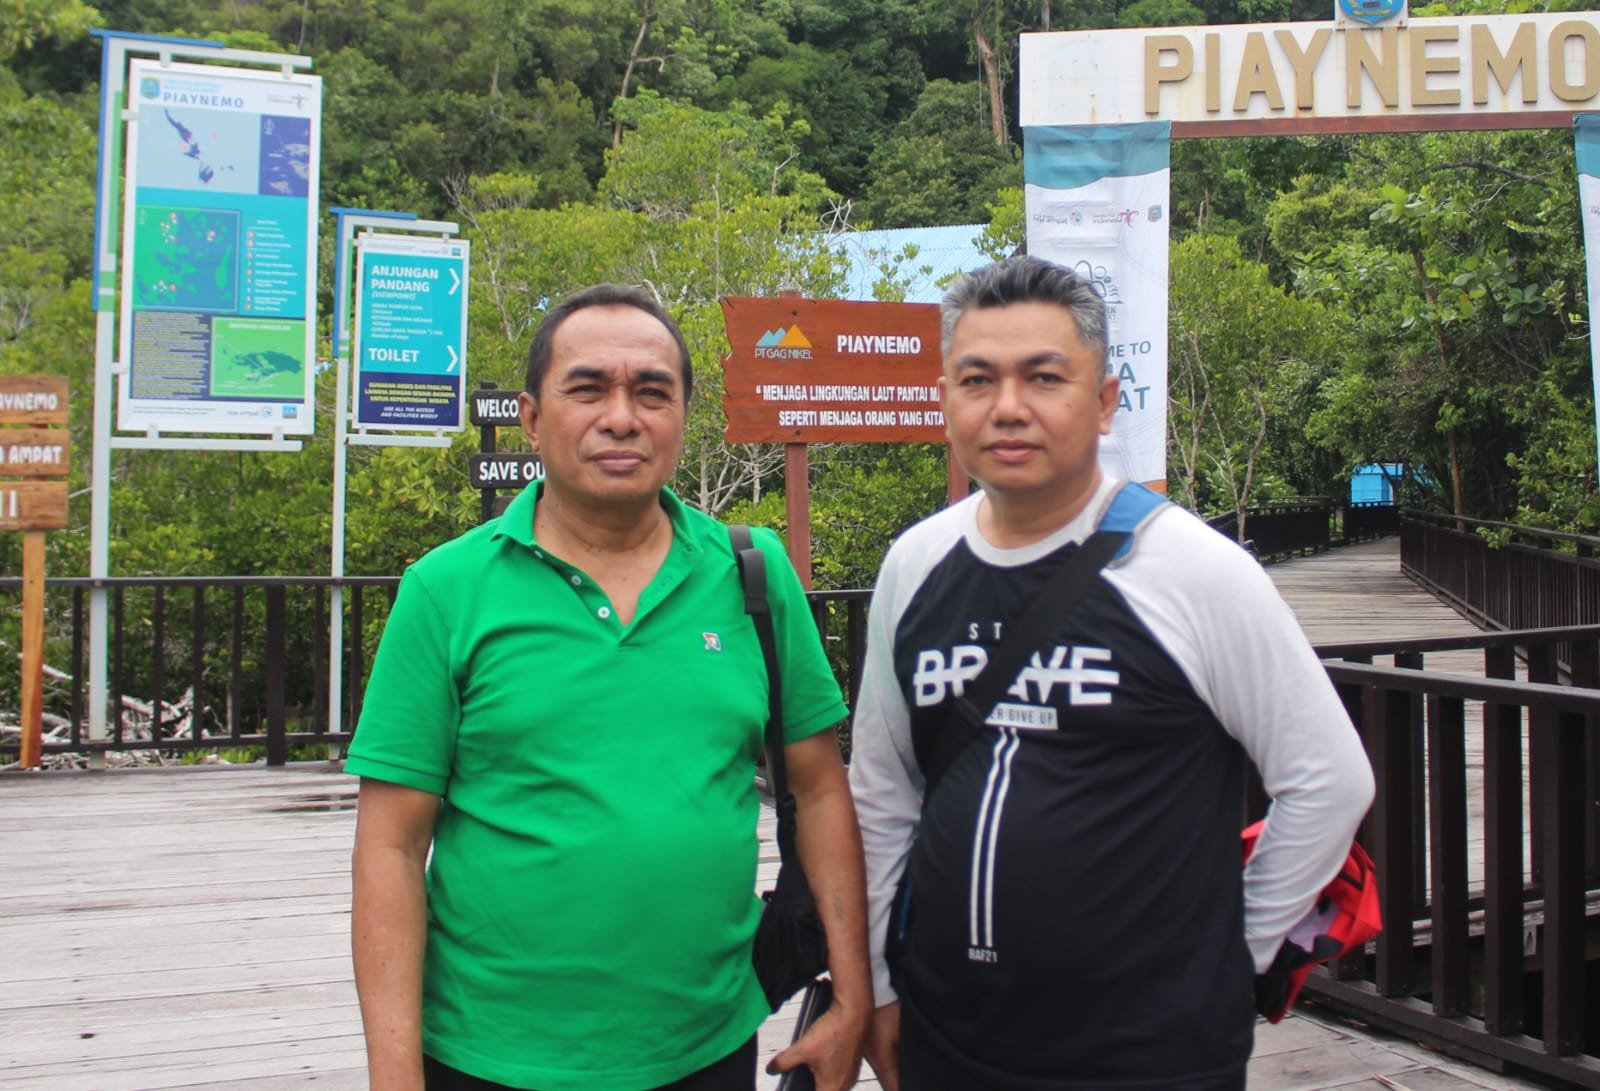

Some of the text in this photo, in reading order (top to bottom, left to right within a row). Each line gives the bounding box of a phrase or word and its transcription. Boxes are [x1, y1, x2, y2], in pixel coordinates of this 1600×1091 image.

[1144, 20, 1600, 115] PIAYNEMO
[163, 91, 245, 109] PIAYNEMO
[371, 265, 438, 279] ANJUNGAN
[371, 279, 430, 292] PANDANG
[837, 334, 922, 354] PIAYNEMO
[1130, 340, 1152, 356] TO
[368, 348, 419, 362] TOILET
[755, 347, 766, 359] PT
[766, 348, 787, 360] GAG
[763, 384, 808, 402] MENJAGA
[809, 386, 870, 402] LINGKUNGAN
[872, 386, 895, 402] LAUT
[897, 386, 928, 402] PANTAI
[930, 387, 940, 402] M
[476, 398, 521, 418] WELCO
[779, 410, 817, 427] SEPERTI
[819, 411, 863, 427] MENJAGA
[865, 411, 896, 427] ORANG
[899, 411, 923, 427] YANG
[8, 445, 63, 464] AMPAT
[479, 461, 547, 481] SAVE OU
[1009, 708, 1034, 724] GIVE
[1040, 710, 1054, 726] UP
